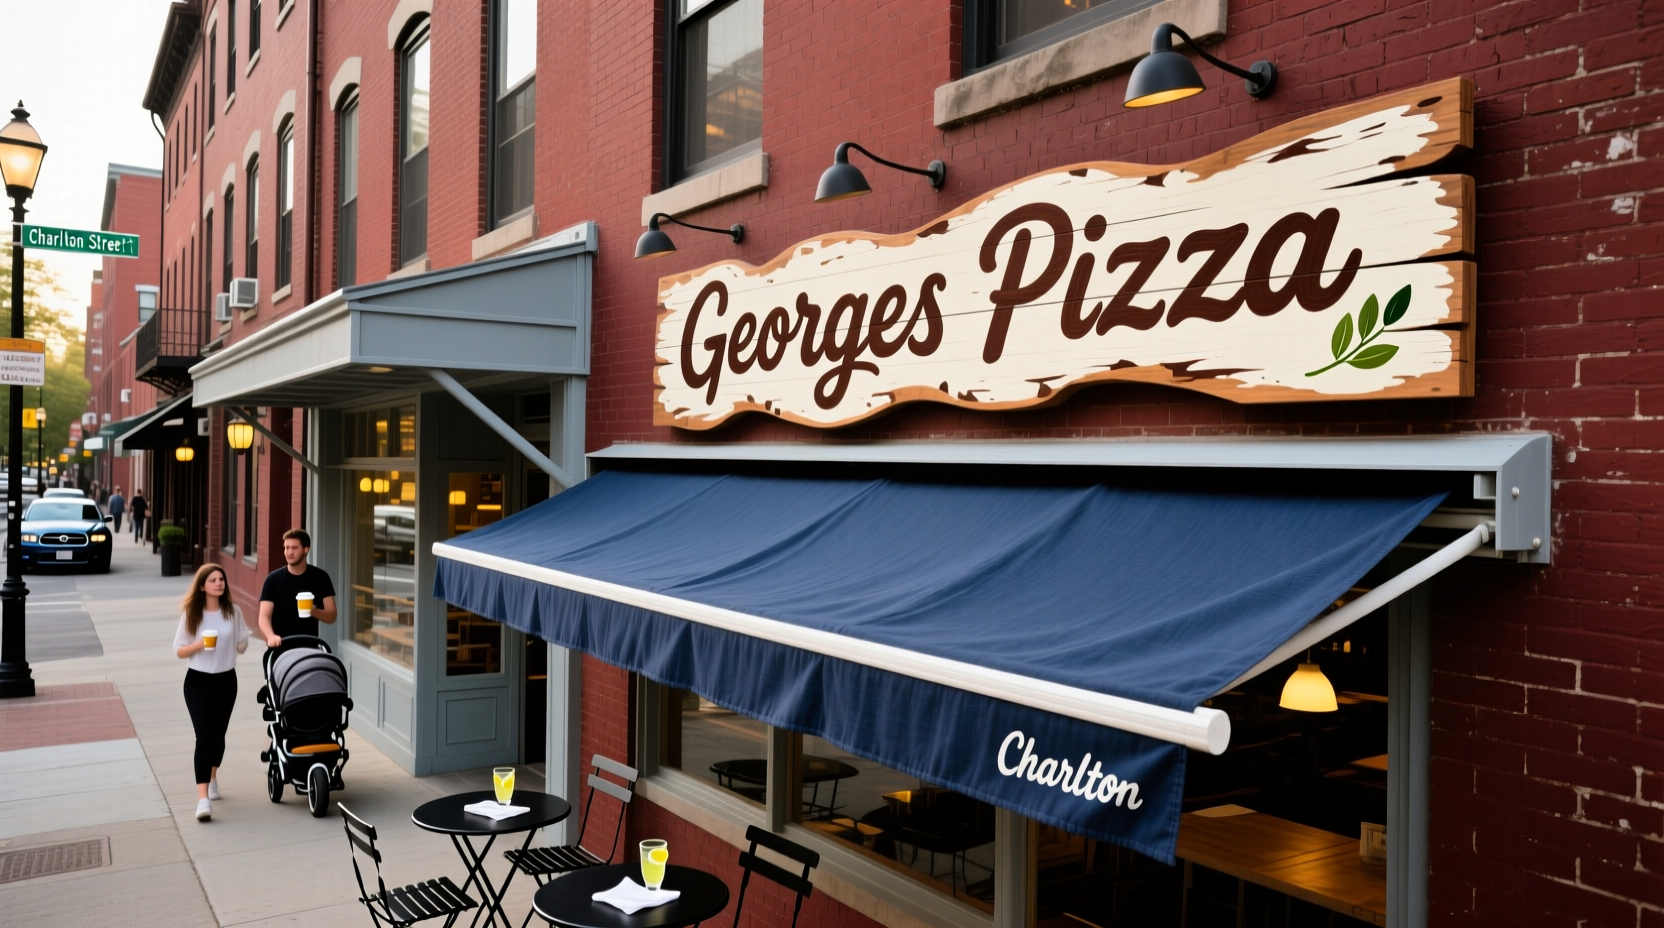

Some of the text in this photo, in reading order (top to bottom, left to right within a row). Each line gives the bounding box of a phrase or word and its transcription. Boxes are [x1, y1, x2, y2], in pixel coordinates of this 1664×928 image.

[680, 202, 1362, 410] Georges Pizza
[997, 730, 1143, 810] Charlton
